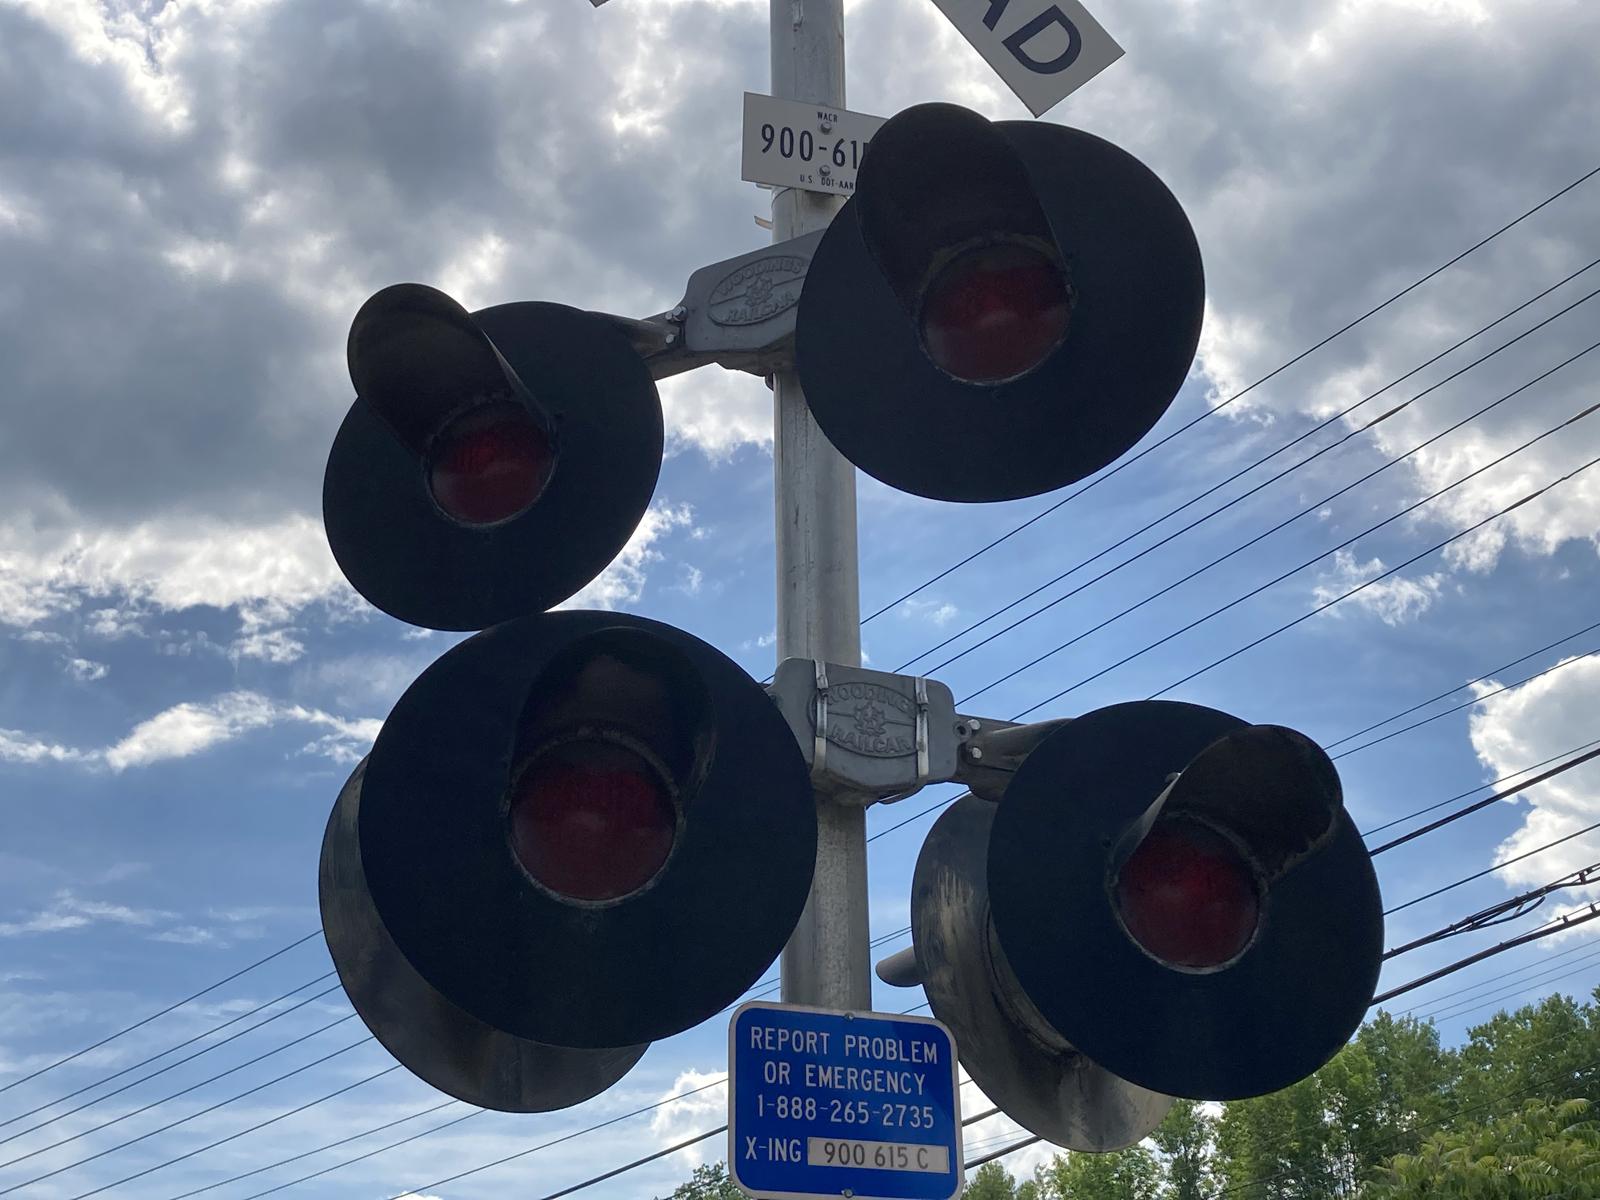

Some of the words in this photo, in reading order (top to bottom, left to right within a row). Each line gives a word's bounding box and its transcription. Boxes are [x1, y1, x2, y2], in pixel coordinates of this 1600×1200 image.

[817, 111, 838, 123] WACR
[761, 123, 869, 170] 900-61
[751, 1026, 830, 1055] REPORT
[844, 1034, 938, 1064] PROBLEM
[764, 1061, 791, 1085] OR
[805, 1063, 926, 1096] EMERGENCY
[757, 1094, 934, 1129] 1-888-265-2735
[745, 1135, 802, 1162] X-ING
[823, 1142, 865, 1166] 900
[874, 1146, 909, 1169] 615
[917, 1147, 929, 1169] C
